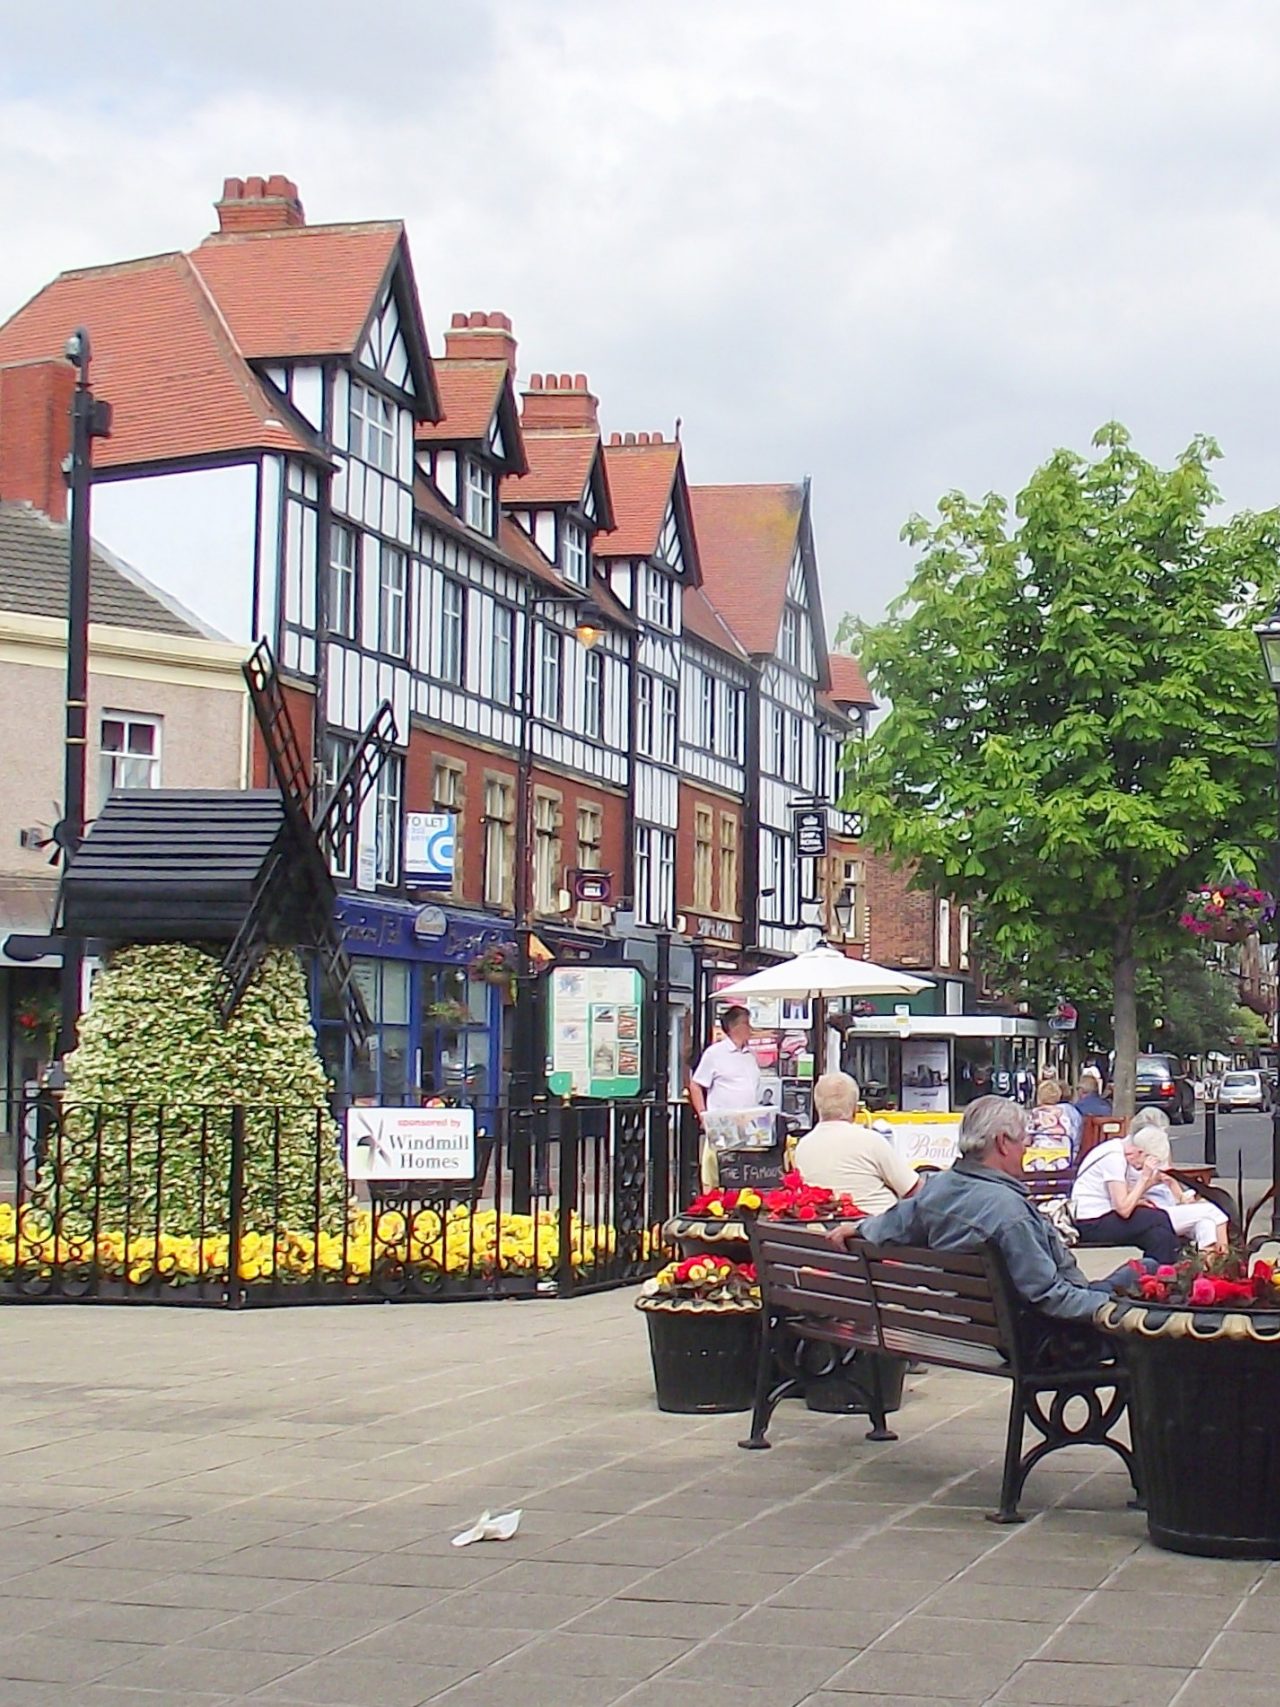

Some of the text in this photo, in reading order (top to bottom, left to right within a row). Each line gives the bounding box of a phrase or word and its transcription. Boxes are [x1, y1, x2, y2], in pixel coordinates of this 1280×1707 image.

[424, 817, 444, 828] LET
[398, 1118, 461, 1128] sponsored by
[389, 1134, 470, 1150] Windmill
[906, 1133, 960, 1159] Bond
[400, 1153, 459, 1169] Homes
